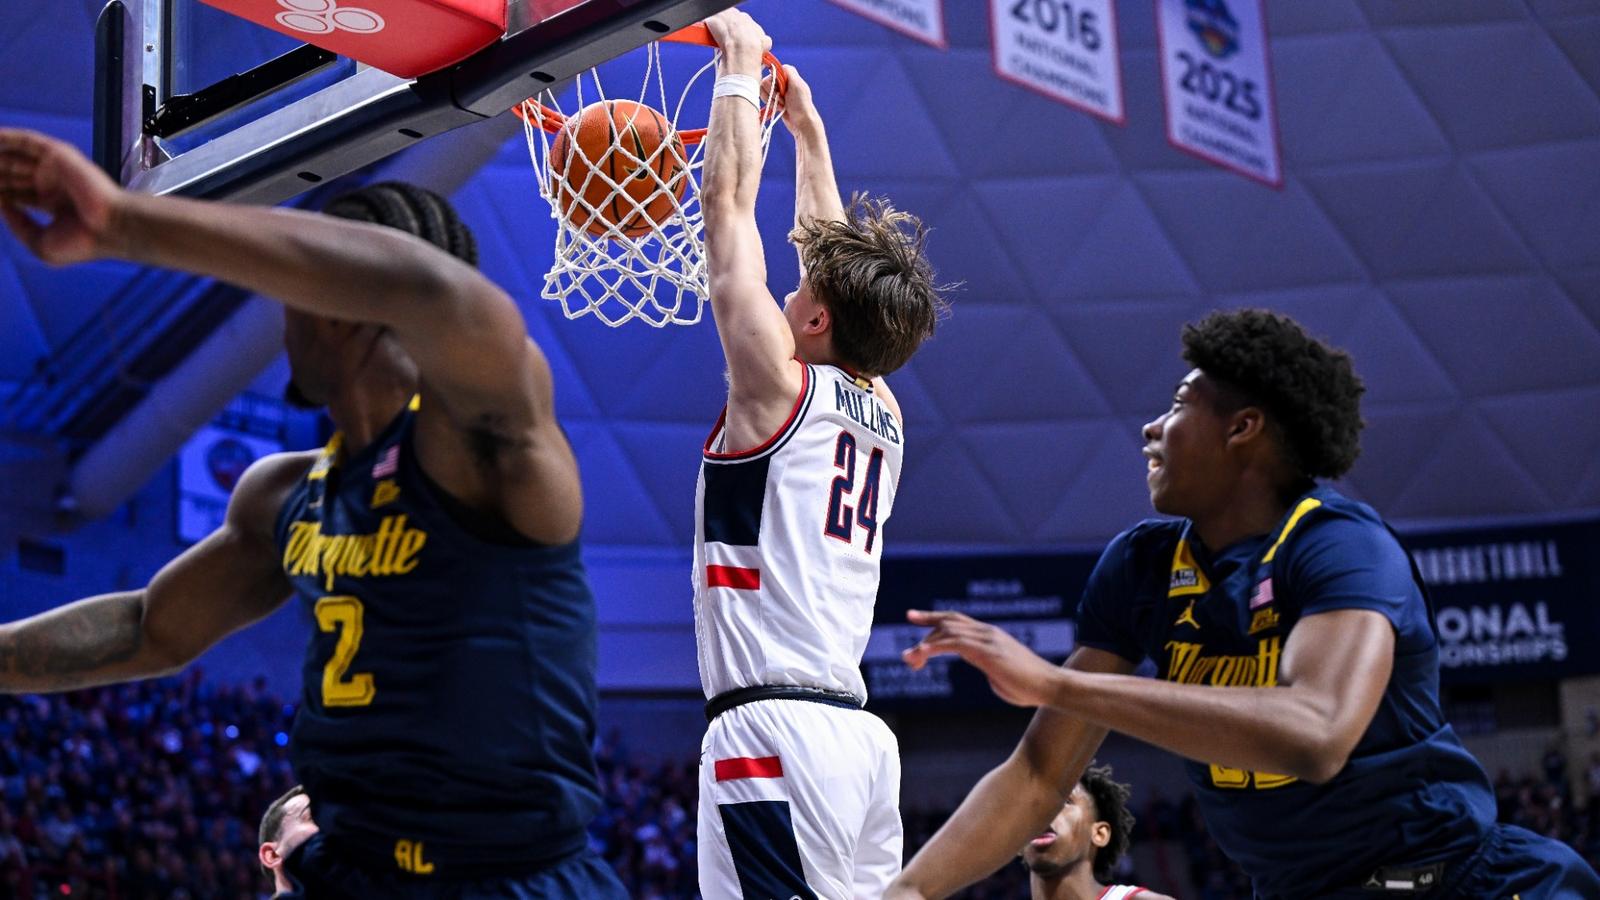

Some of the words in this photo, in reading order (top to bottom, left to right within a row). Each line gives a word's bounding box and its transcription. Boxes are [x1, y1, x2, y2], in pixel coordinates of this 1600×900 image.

[1010, 0, 1101, 51] 2016
[1177, 52, 1262, 120] 2025
[834, 381, 900, 444] MULLINS
[824, 430, 884, 554] 24
[315, 597, 375, 706] 2
[1437, 602, 1563, 641] ONAL
